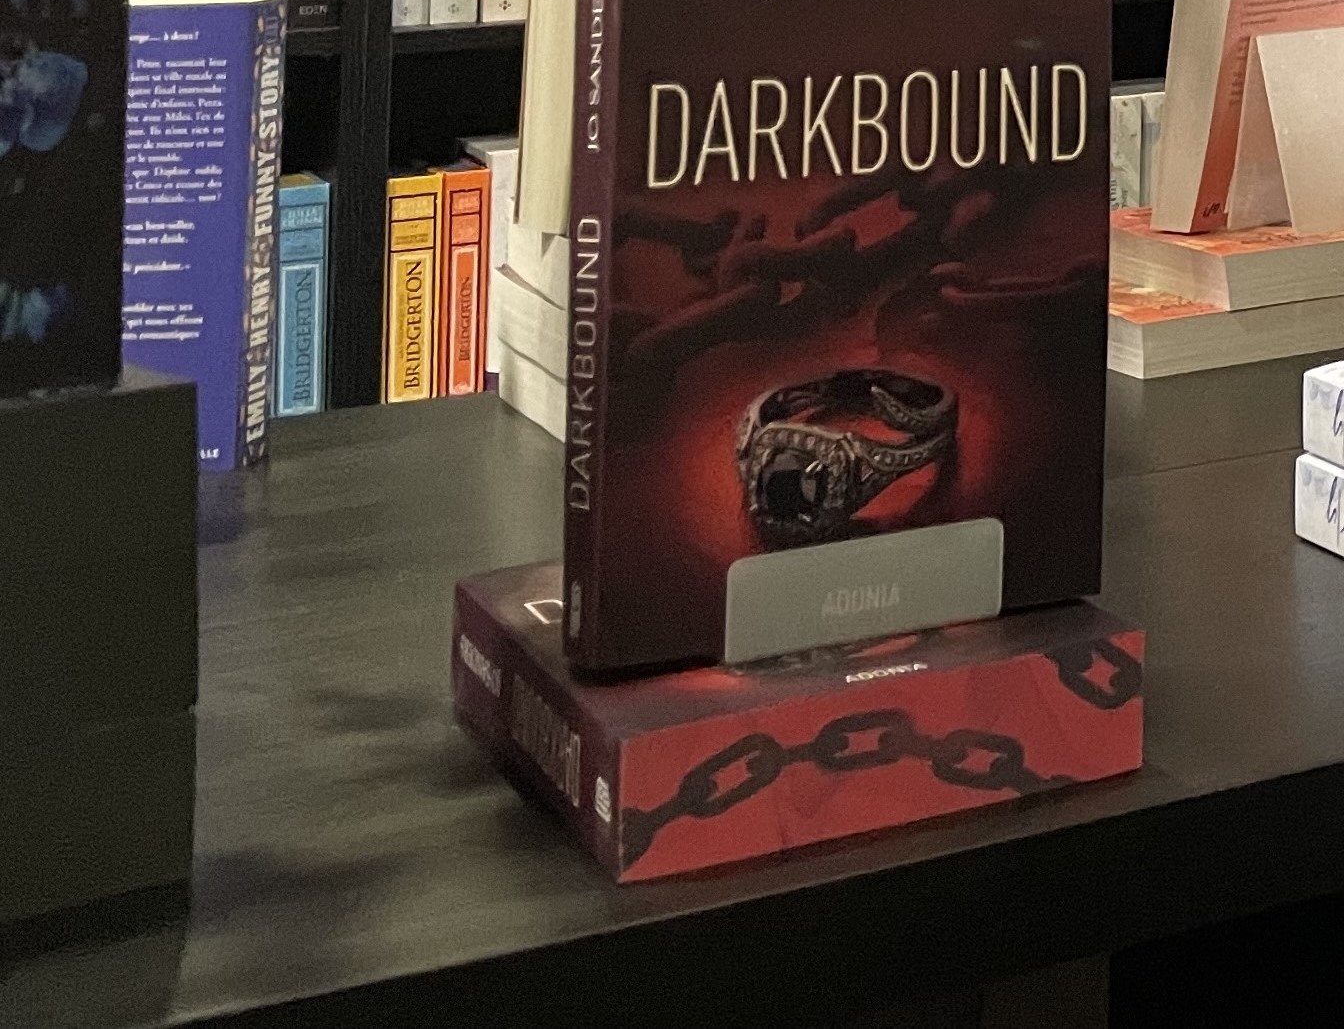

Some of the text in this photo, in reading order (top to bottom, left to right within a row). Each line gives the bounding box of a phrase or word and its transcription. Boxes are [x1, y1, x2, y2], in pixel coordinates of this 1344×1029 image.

[647, 63, 1088, 190] DARKBOUND
[246, 57, 280, 443] EMILY HENRY FUNNY STORY
[293, 271, 313, 401] BRIDGERTON
[404, 261, 422, 389] BRIDGERTON
[458, 277, 471, 362] BRIDGERTON
[568, 217, 601, 511] DARKBOUND
